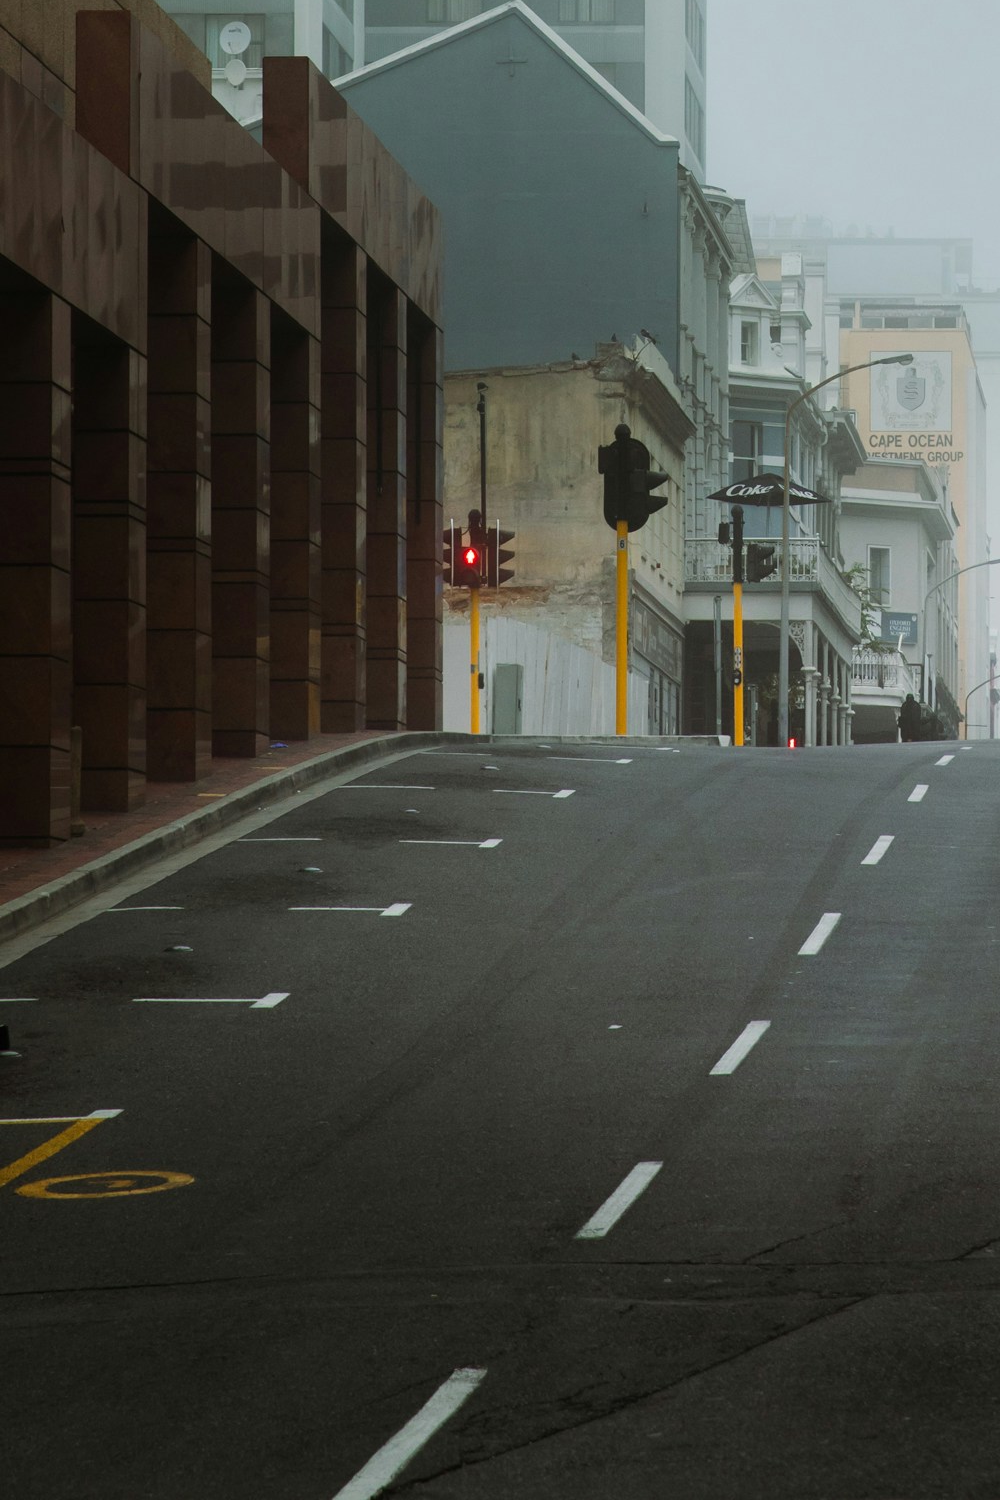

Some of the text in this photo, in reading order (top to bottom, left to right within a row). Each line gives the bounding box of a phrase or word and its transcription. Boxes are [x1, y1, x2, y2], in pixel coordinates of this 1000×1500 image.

[869, 434, 953, 447] CAPE OCEAN
[867, 451, 964, 461] VESTMENT GROUP
[726, 484, 774, 497] Coke
[778, 484, 817, 499] ke
